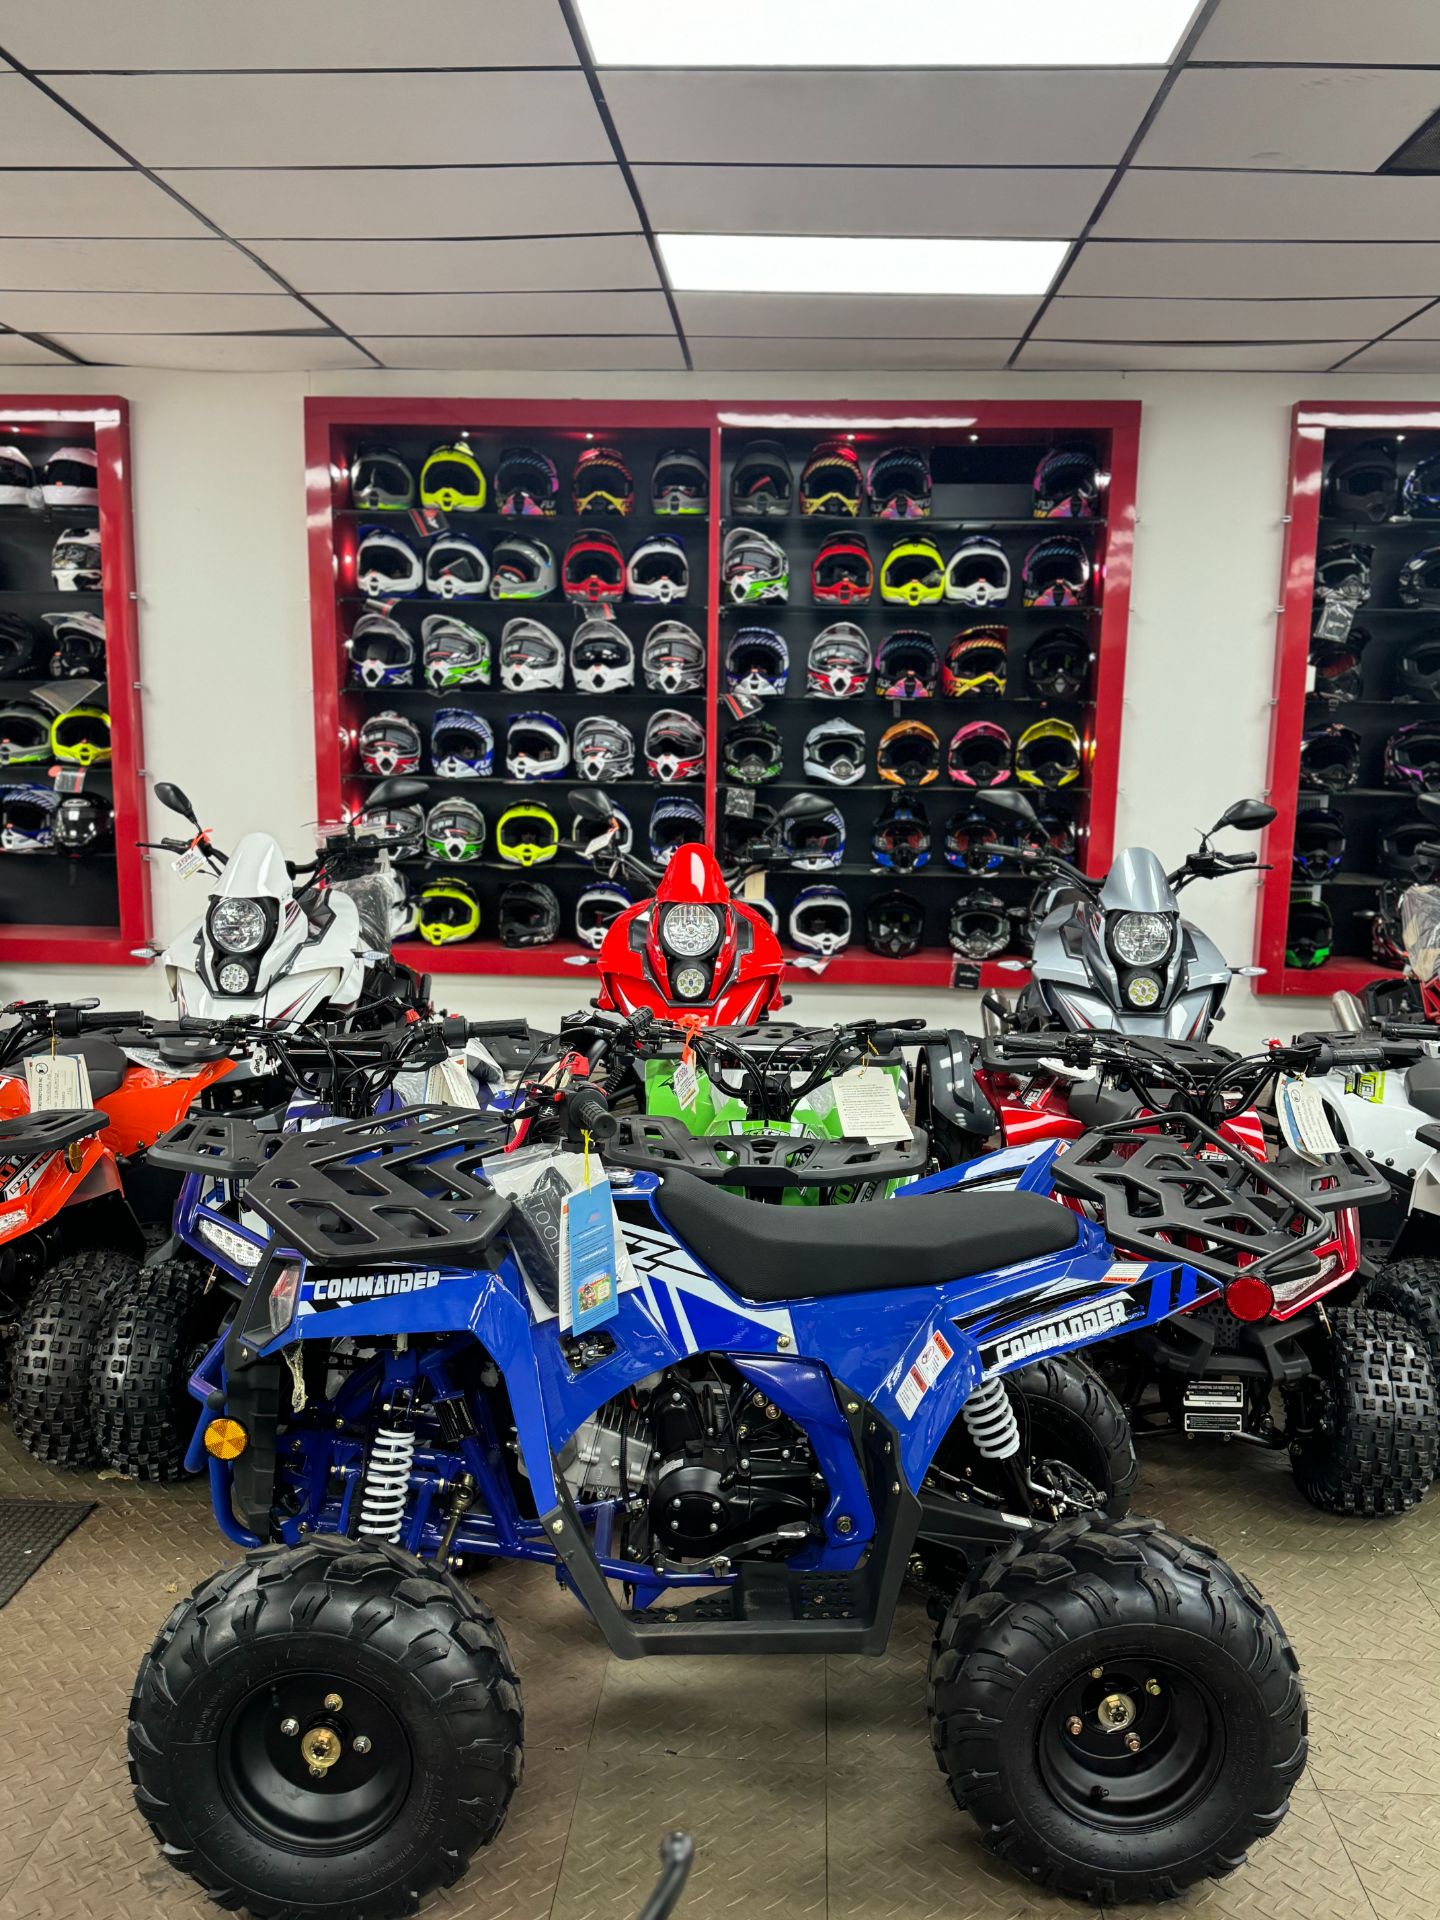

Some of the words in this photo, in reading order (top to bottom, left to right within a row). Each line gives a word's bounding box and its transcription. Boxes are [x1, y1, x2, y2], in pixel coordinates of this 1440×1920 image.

[540, 499, 556, 510] FLY
[313, 1271, 440, 1300] COMMANDER
[996, 1301, 1129, 1363] COMMANDER
